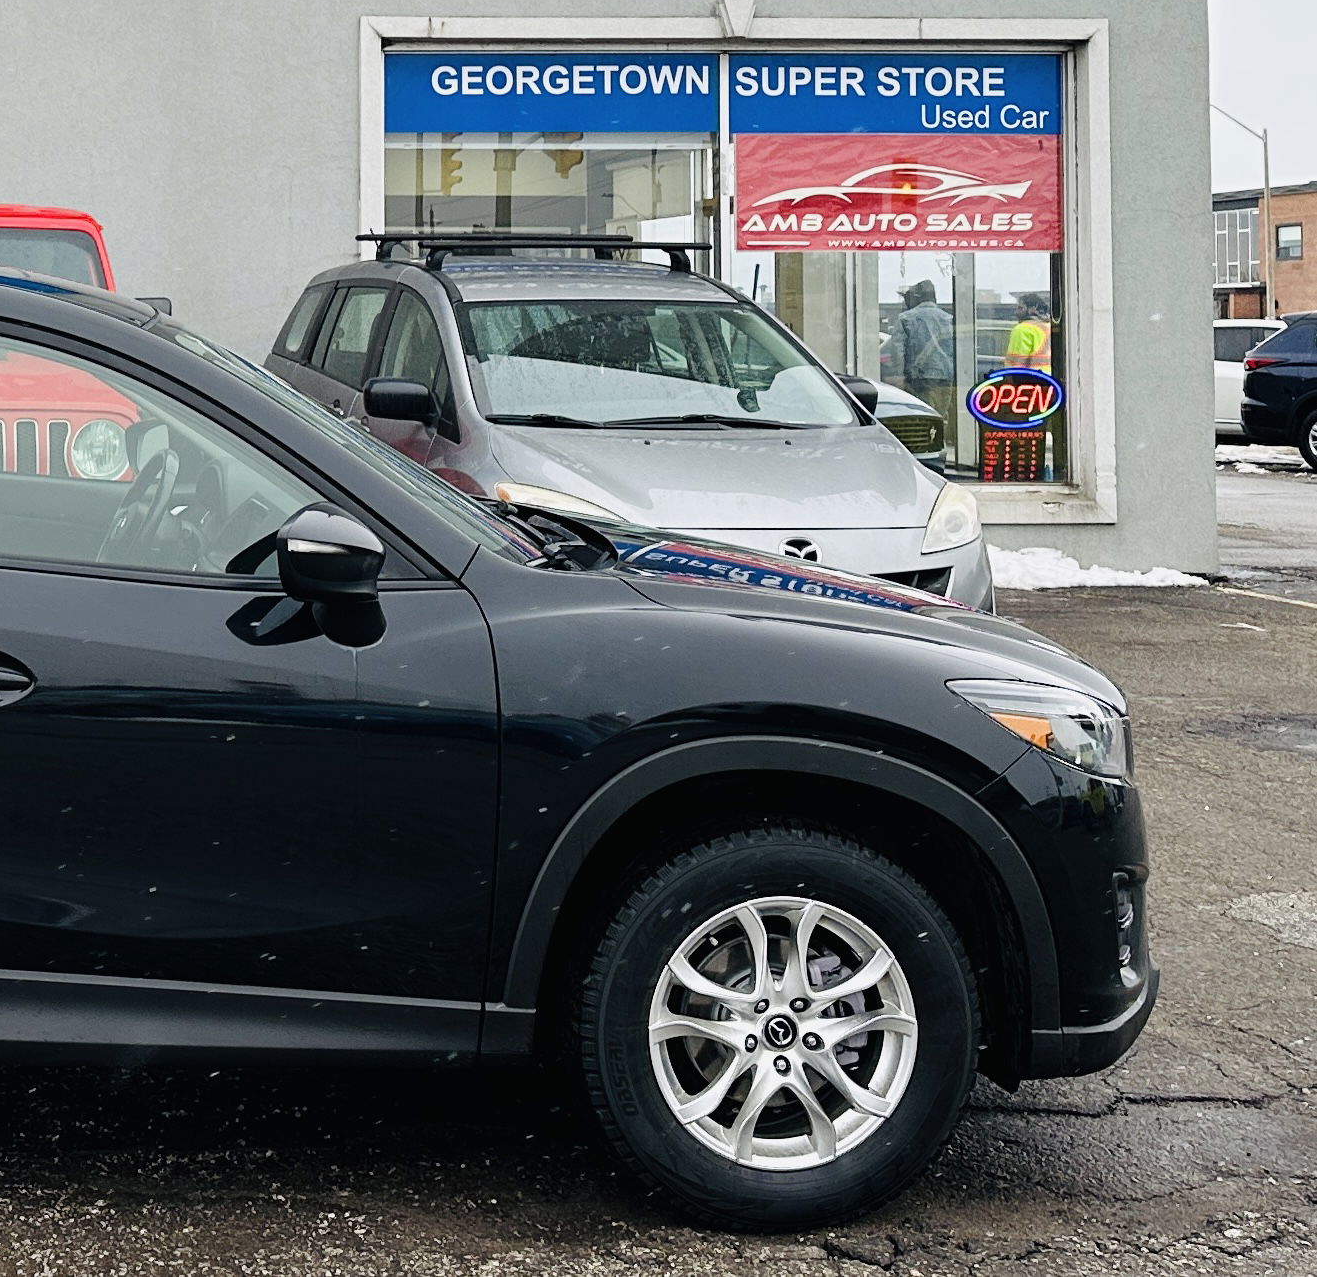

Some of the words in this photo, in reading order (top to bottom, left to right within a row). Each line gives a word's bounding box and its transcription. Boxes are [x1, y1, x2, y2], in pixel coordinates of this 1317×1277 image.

[430, 65, 710, 97] GEORGETOWN
[734, 66, 866, 97] SUPER
[876, 66, 1006, 97] STORE
[920, 103, 991, 130] Used
[999, 103, 1050, 130] Car
[741, 213, 823, 233] AMB
[827, 213, 918, 233] AUTO
[924, 213, 1034, 233] SALES
[974, 383, 1054, 414] OPEN
